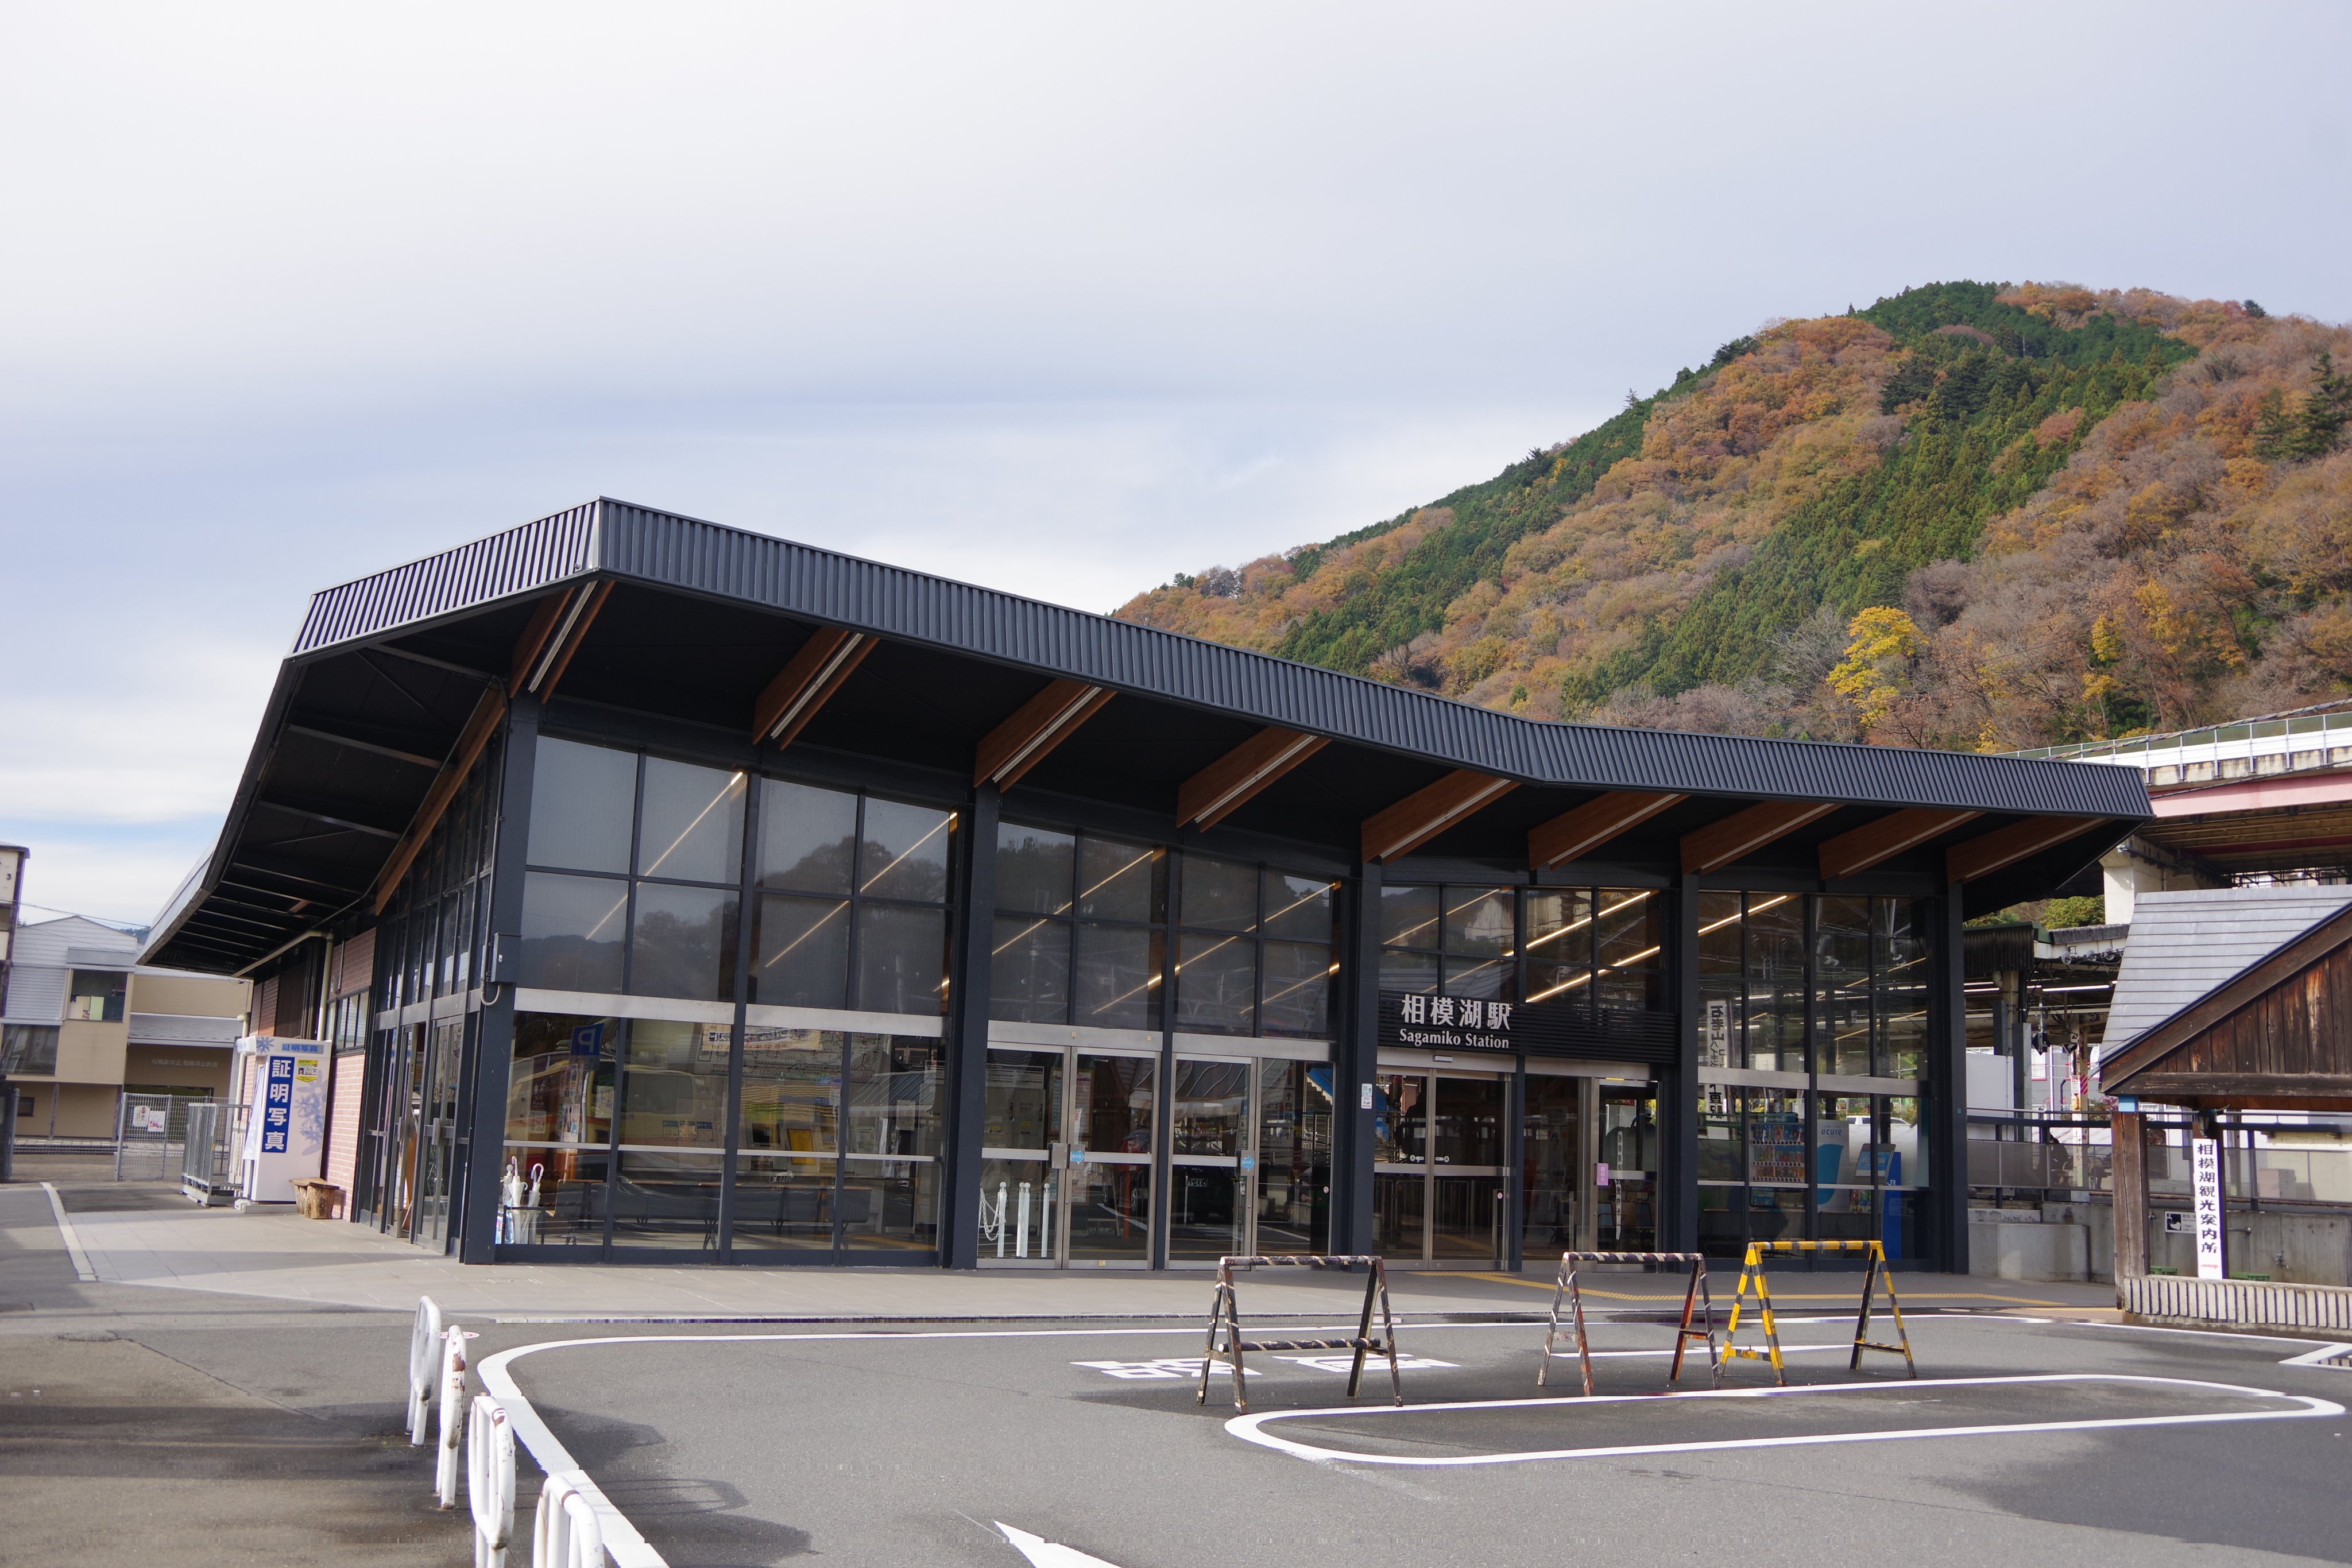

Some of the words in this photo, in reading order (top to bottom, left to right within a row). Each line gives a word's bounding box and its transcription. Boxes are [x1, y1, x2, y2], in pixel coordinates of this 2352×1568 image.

[1401, 994, 1510, 1030] 相模湖駅
[282, 1044, 319, 1052] 証明写真
[1399, 1028, 1461, 1047] Sagamiko
[1465, 1033, 1509, 1049] Station
[265, 1059, 292, 1151] 証明写真
[2198, 1143, 2218, 1254] 相模湖観光案内所
